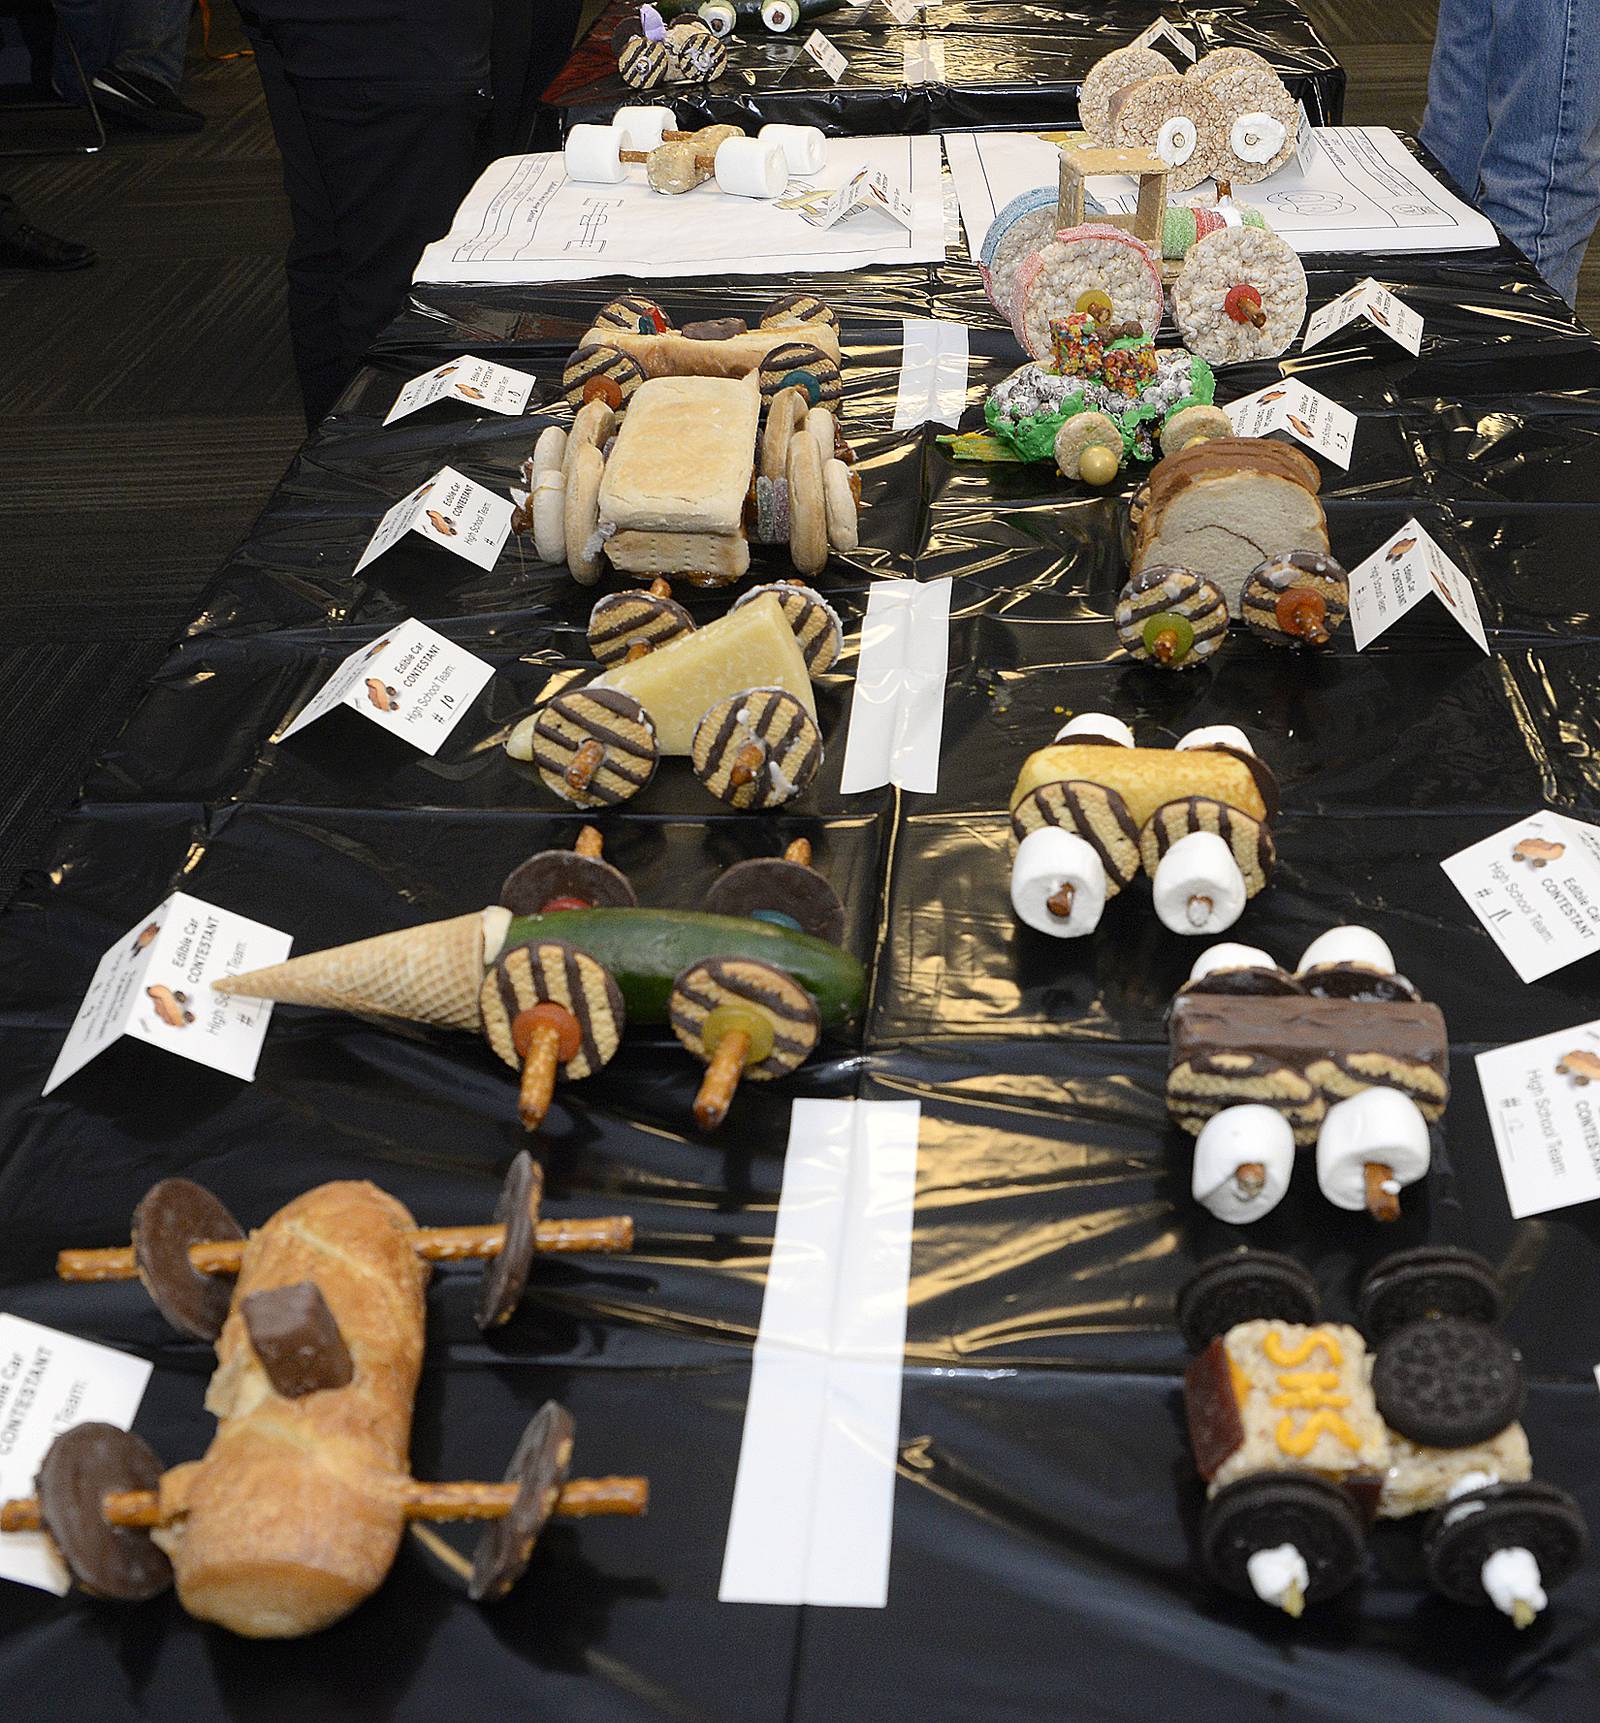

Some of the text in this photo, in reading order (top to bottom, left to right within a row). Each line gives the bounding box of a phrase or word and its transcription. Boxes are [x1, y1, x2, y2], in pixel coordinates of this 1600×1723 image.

[452, 484, 474, 516] CONTESTANT
[394, 642, 424, 674] Edible Car
[403, 644, 440, 687] CONTESTANT
[405, 705, 424, 724] High
[417, 682, 441, 707] School
[440, 694, 455, 710] 10
[1488, 861, 1510, 883] High
[1506, 883, 1536, 914] School
[1563, 877, 1589, 905] Edible
[1541, 878, 1595, 939] CONTESTANT
[172, 918, 199, 968] Edible Car
[187, 916, 219, 984] CONTESTANT
[206, 1009, 225, 1036] High
[1527, 1069, 1545, 1097] High
[1535, 1097, 1558, 1138] School
